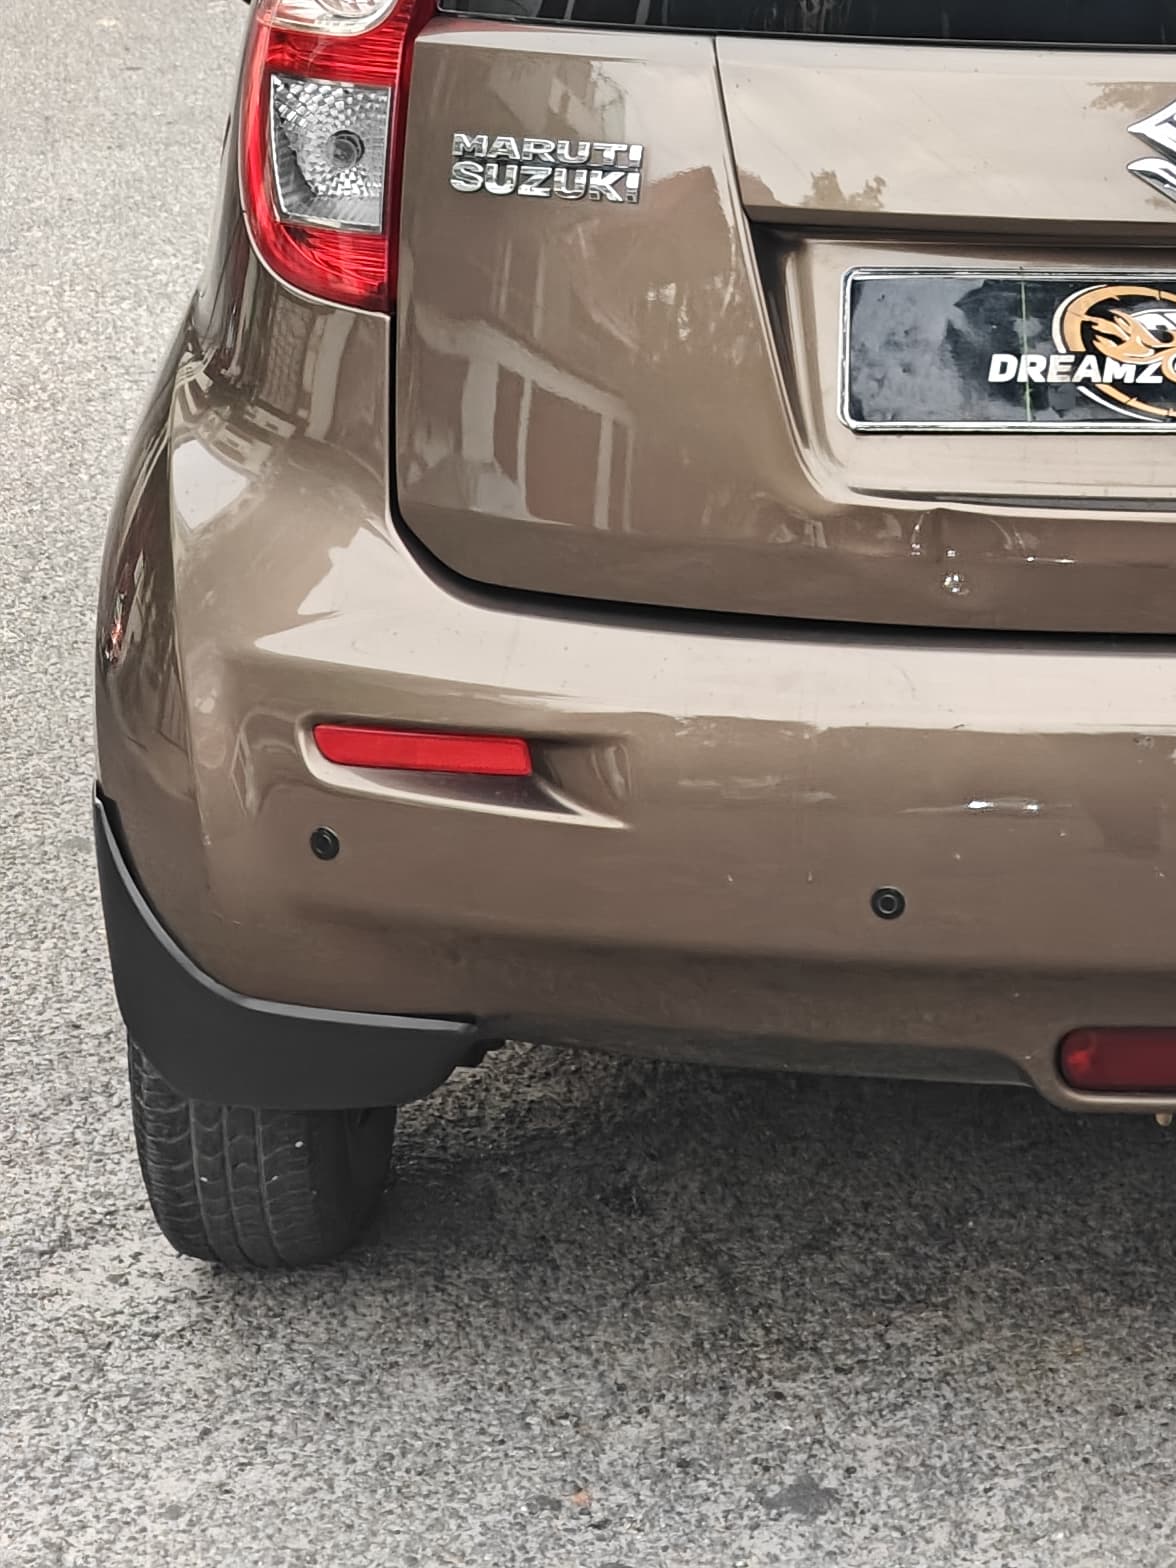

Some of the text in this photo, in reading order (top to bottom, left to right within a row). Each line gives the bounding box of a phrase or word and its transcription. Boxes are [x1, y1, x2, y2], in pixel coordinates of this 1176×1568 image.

[452, 133, 645, 168] MARUTI
[450, 160, 641, 204] SUZUKI
[988, 352, 1164, 384] DREAMZ
